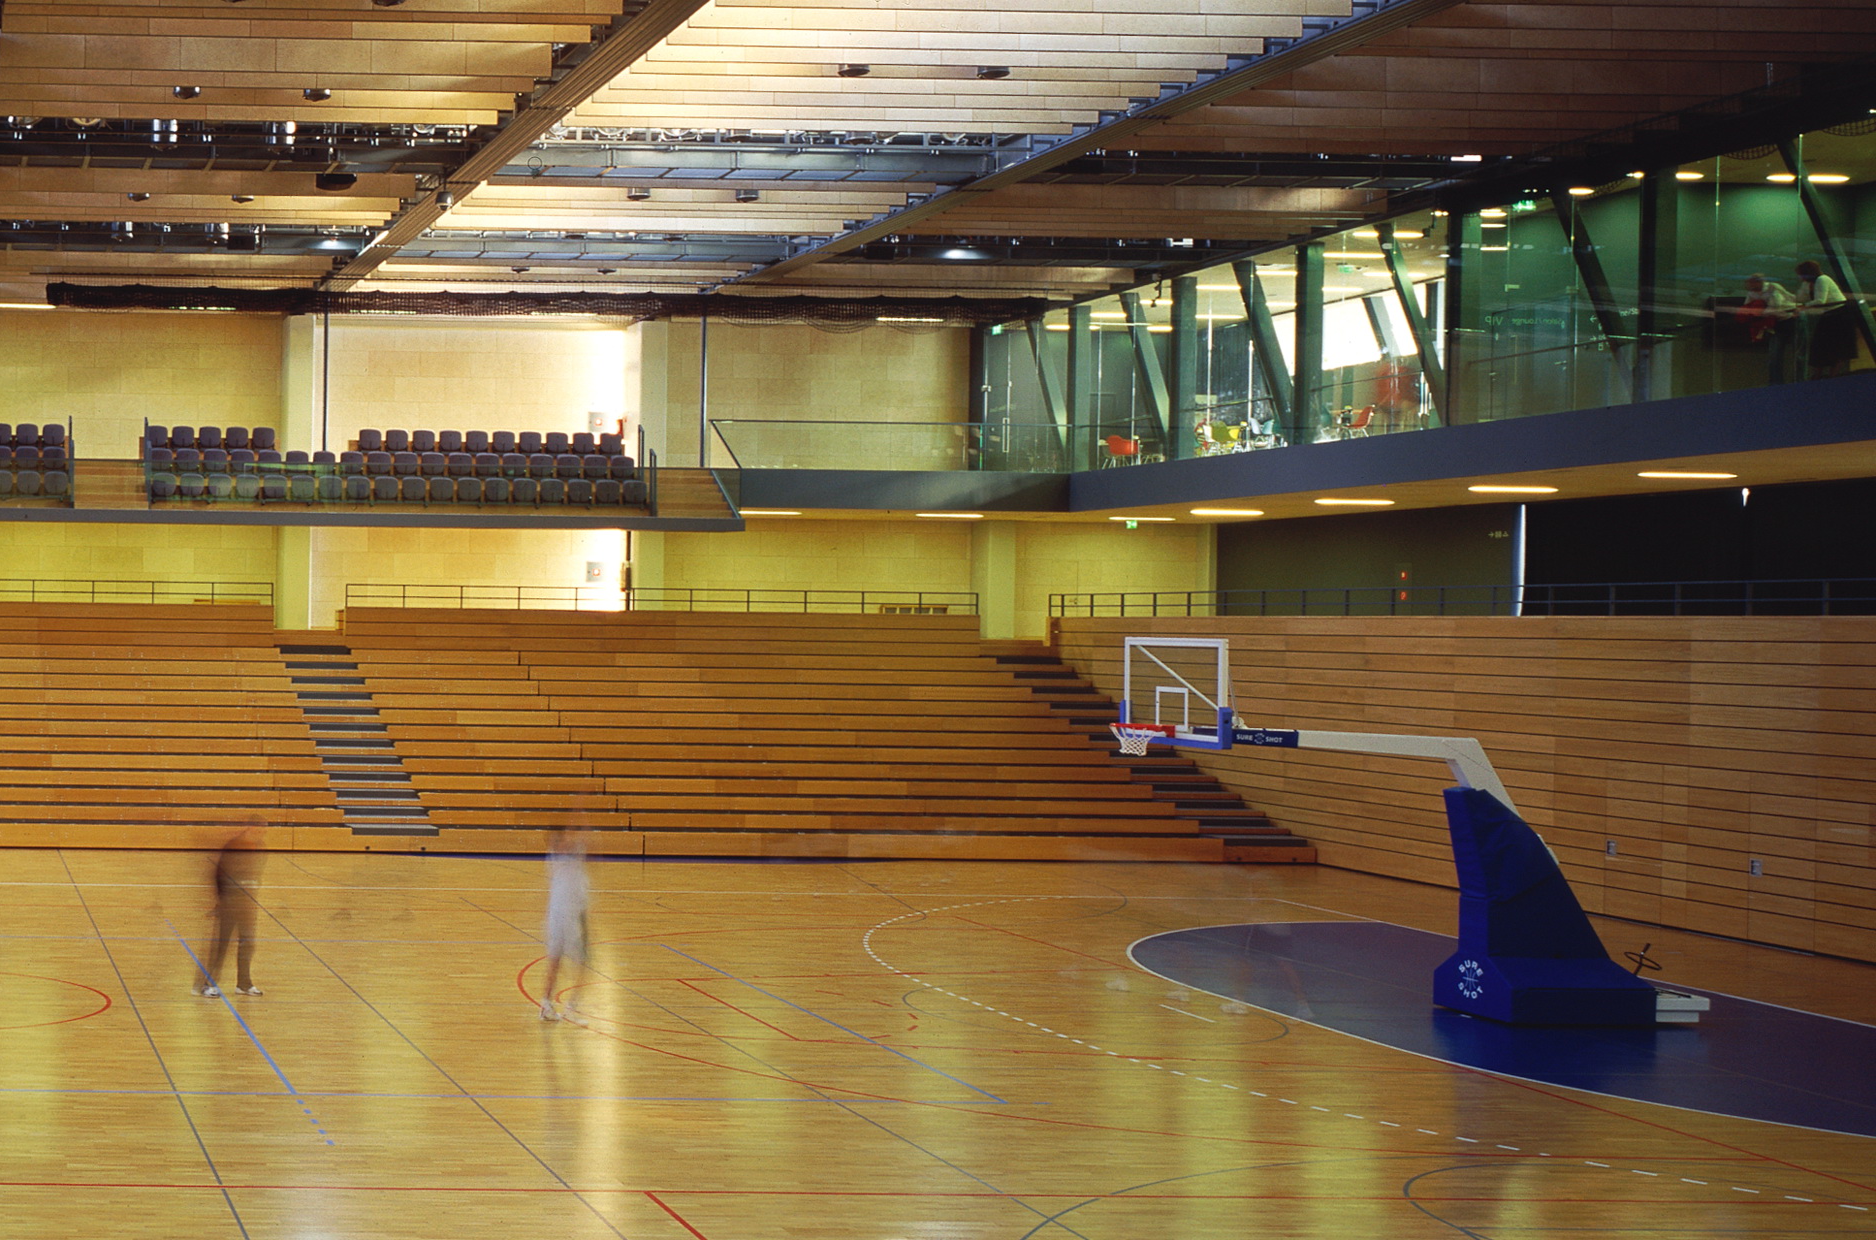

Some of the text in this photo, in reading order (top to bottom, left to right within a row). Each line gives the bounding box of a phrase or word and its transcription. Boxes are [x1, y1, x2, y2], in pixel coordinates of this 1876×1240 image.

[1236, 733, 1254, 741] SURE
[1458, 959, 1484, 977] SURE
[1457, 982, 1484, 999] SHOT
